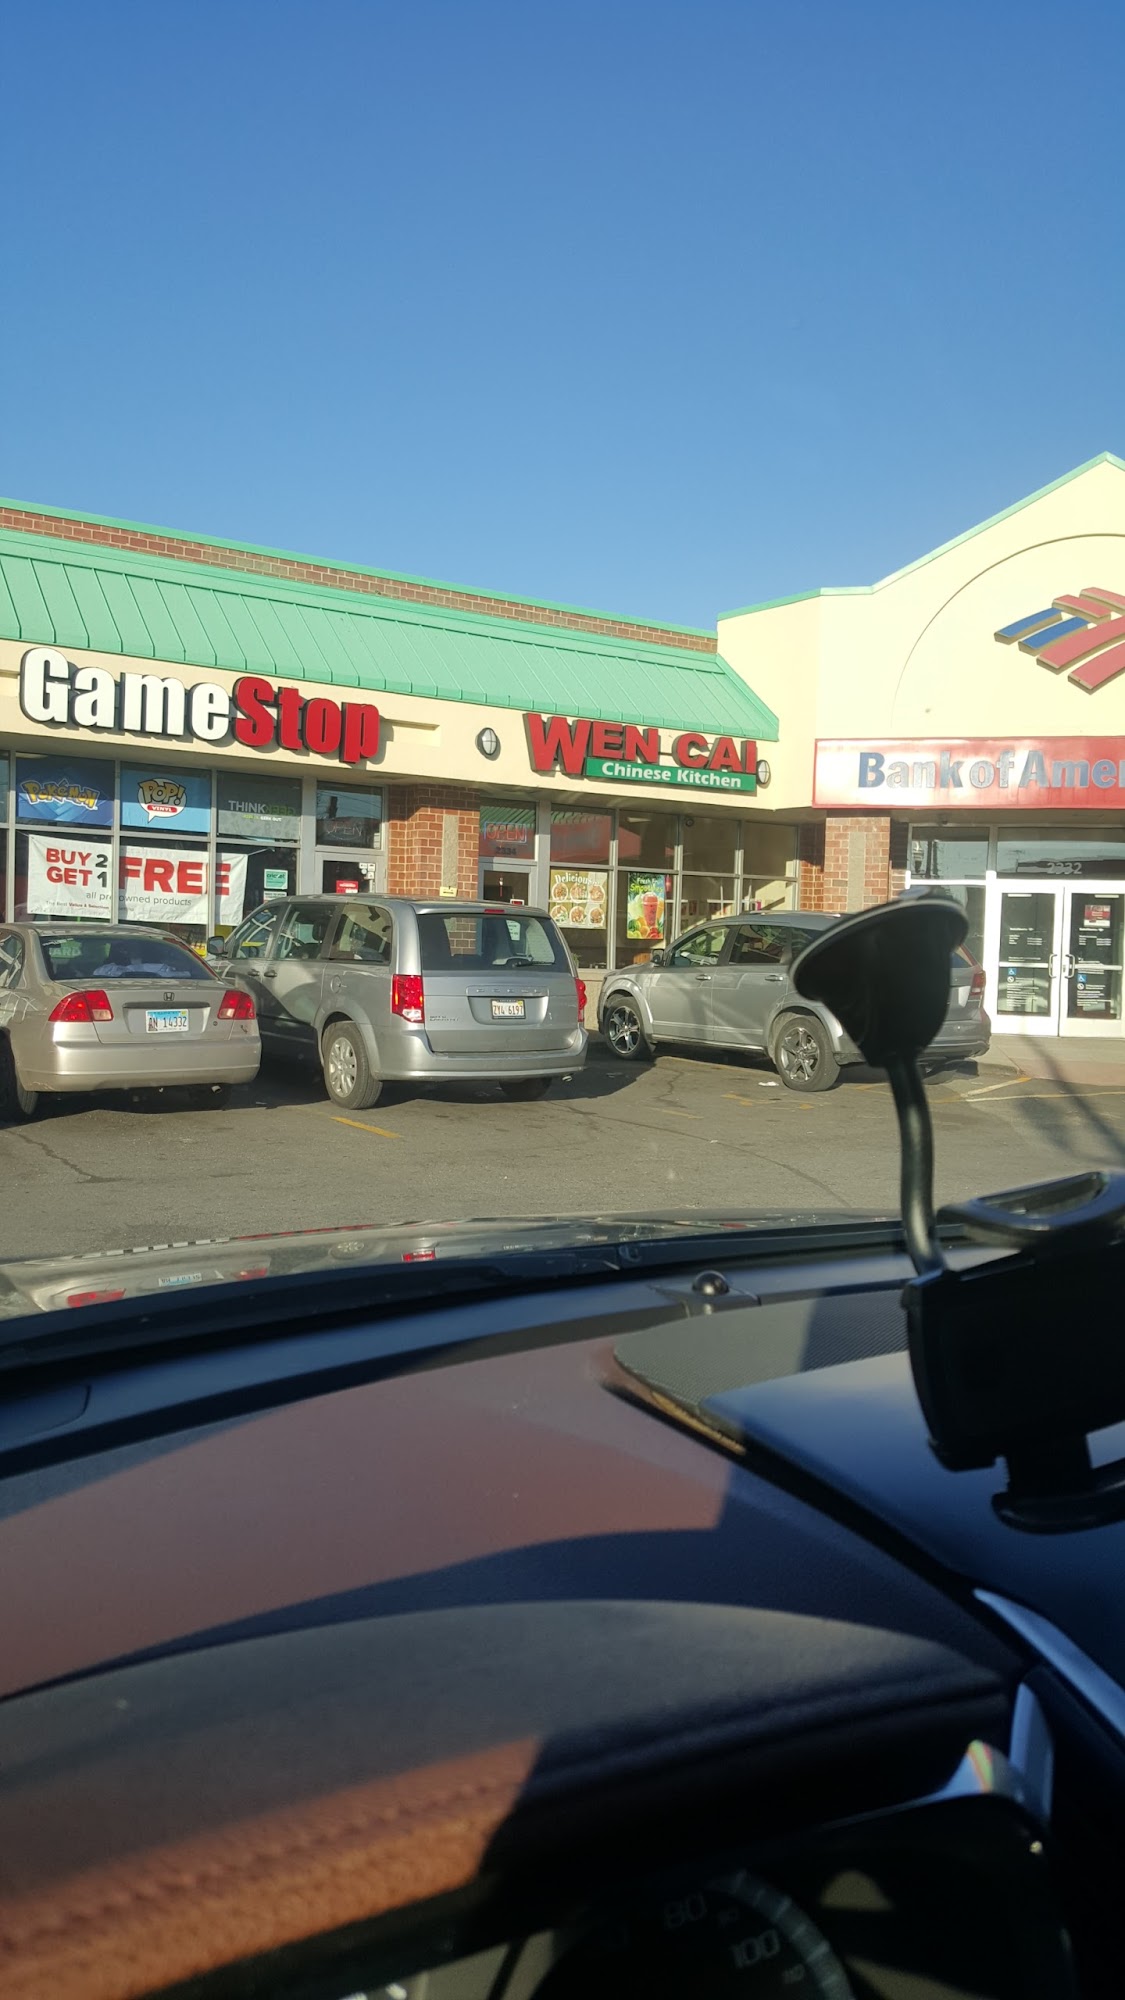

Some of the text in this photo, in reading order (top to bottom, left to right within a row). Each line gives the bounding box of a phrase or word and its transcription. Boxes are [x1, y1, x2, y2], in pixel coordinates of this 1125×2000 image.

[20, 647, 380, 763] GameStop
[523, 712, 757, 775] WEN CAI
[601, 761, 742, 789] Chinese Kitchen
[858, 750, 965, 789] Bank
[969, 749, 1015, 789] of
[228, 800, 266, 814] THINK
[486, 823, 525, 840] OPEN
[45, 847, 109, 868] BUY 2
[46, 866, 108, 888] GET 1
[118, 856, 232, 896] FREE
[1046, 862, 1083, 875] 2332
[118, 894, 151, 904] owned
[153, 896, 192, 907] products
[163, 1016, 187, 1028] 14332
